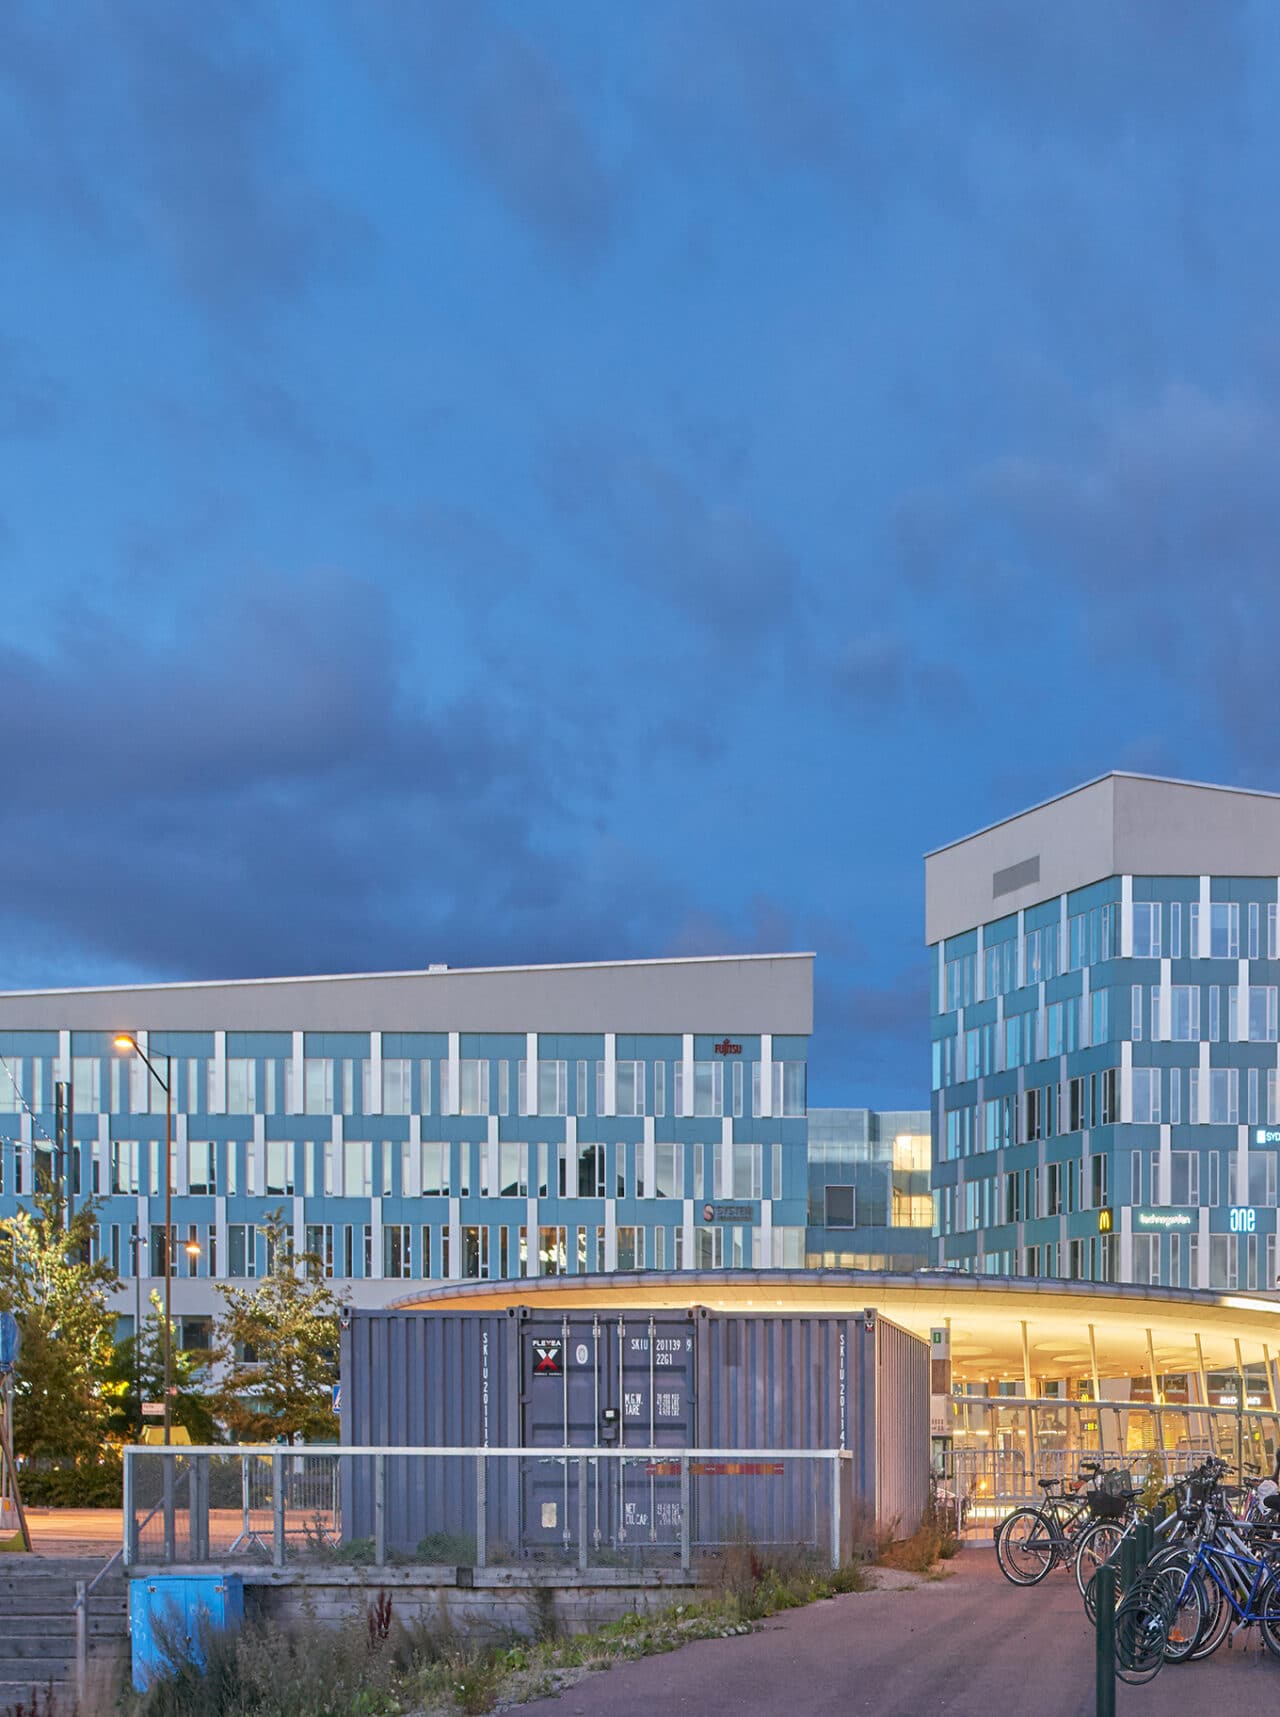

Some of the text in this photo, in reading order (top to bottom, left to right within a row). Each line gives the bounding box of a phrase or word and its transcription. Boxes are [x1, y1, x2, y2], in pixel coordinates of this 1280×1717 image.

[715, 1039, 742, 1056] FUJITSU
[631, 1338, 648, 1350] SKIU
[656, 1339, 681, 1351] 201139
